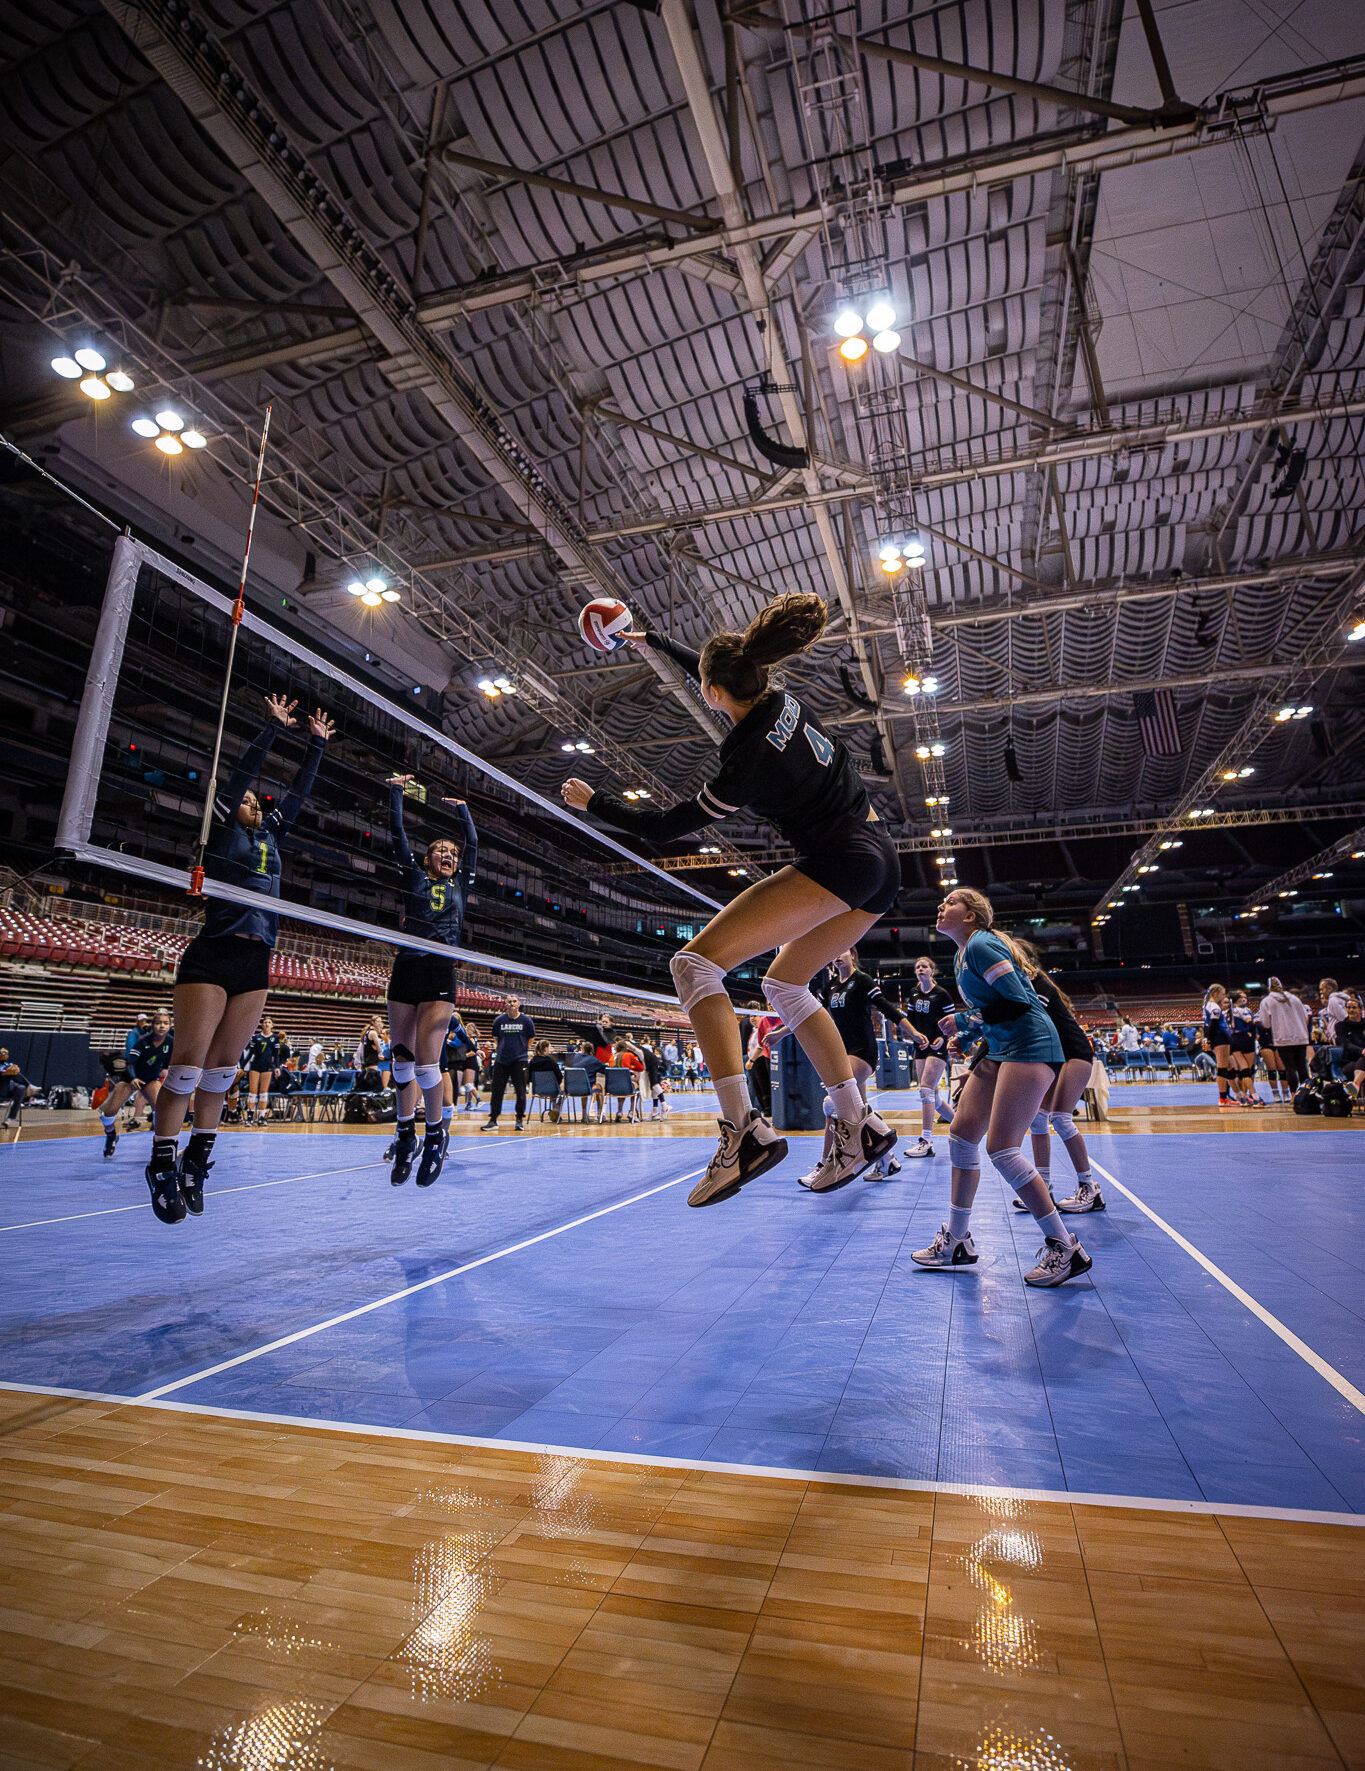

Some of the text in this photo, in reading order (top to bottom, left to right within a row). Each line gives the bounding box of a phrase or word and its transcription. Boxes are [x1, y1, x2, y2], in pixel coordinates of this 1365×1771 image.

[765, 693, 801, 753] MOD
[802, 721, 836, 768] 4
[256, 841, 268, 874] 1
[430, 884, 446, 912] 5
[830, 991, 847, 1009] 24
[260, 1041, 268, 1053] 7
